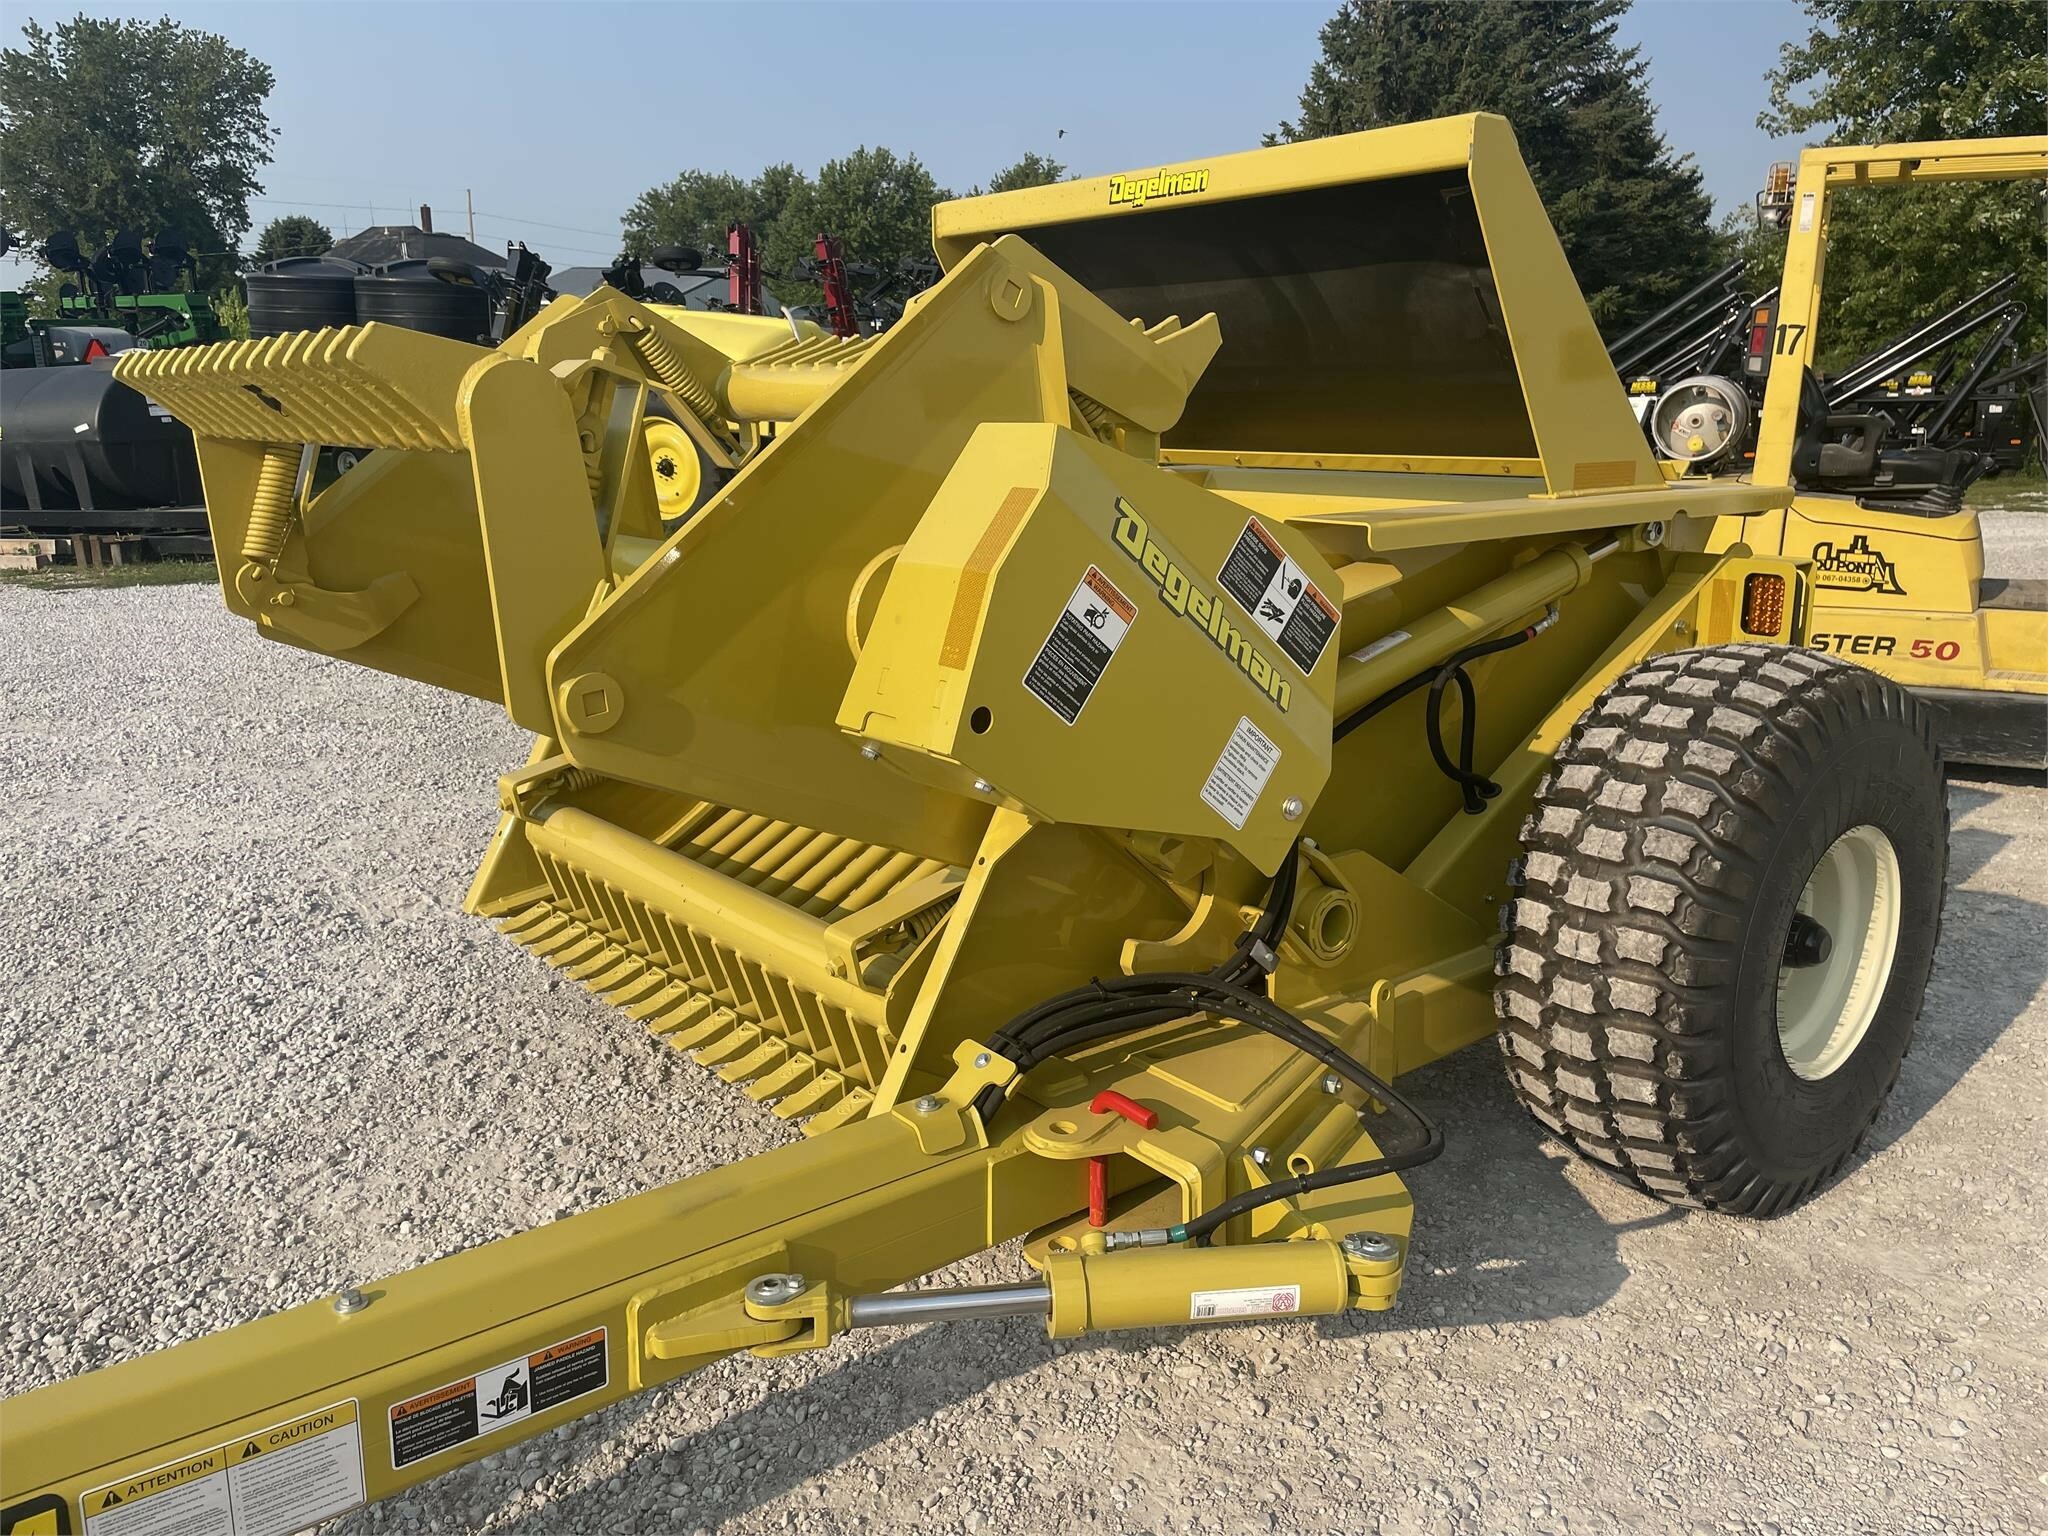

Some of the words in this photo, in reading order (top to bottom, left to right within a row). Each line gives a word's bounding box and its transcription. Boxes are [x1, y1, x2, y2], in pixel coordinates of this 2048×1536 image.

[1109, 168, 1209, 208] Degelman
[1776, 324, 1806, 355] 17
[1837, 561, 1875, 574] PONT
[1092, 582, 1116, 608] WARNING
[1096, 575, 1133, 614] AVERTISSEMENT
[1111, 496, 1291, 713] Degelman
[1909, 640, 1960, 661] 50
[1245, 725, 1273, 755] IMPORTANT
[556, 1334, 592, 1354] WARNING
[408, 1381, 470, 1411] AVERTISSEMENT
[269, 1414, 334, 1445] CAUTION
[127, 1457, 214, 1497] ATTENTION
